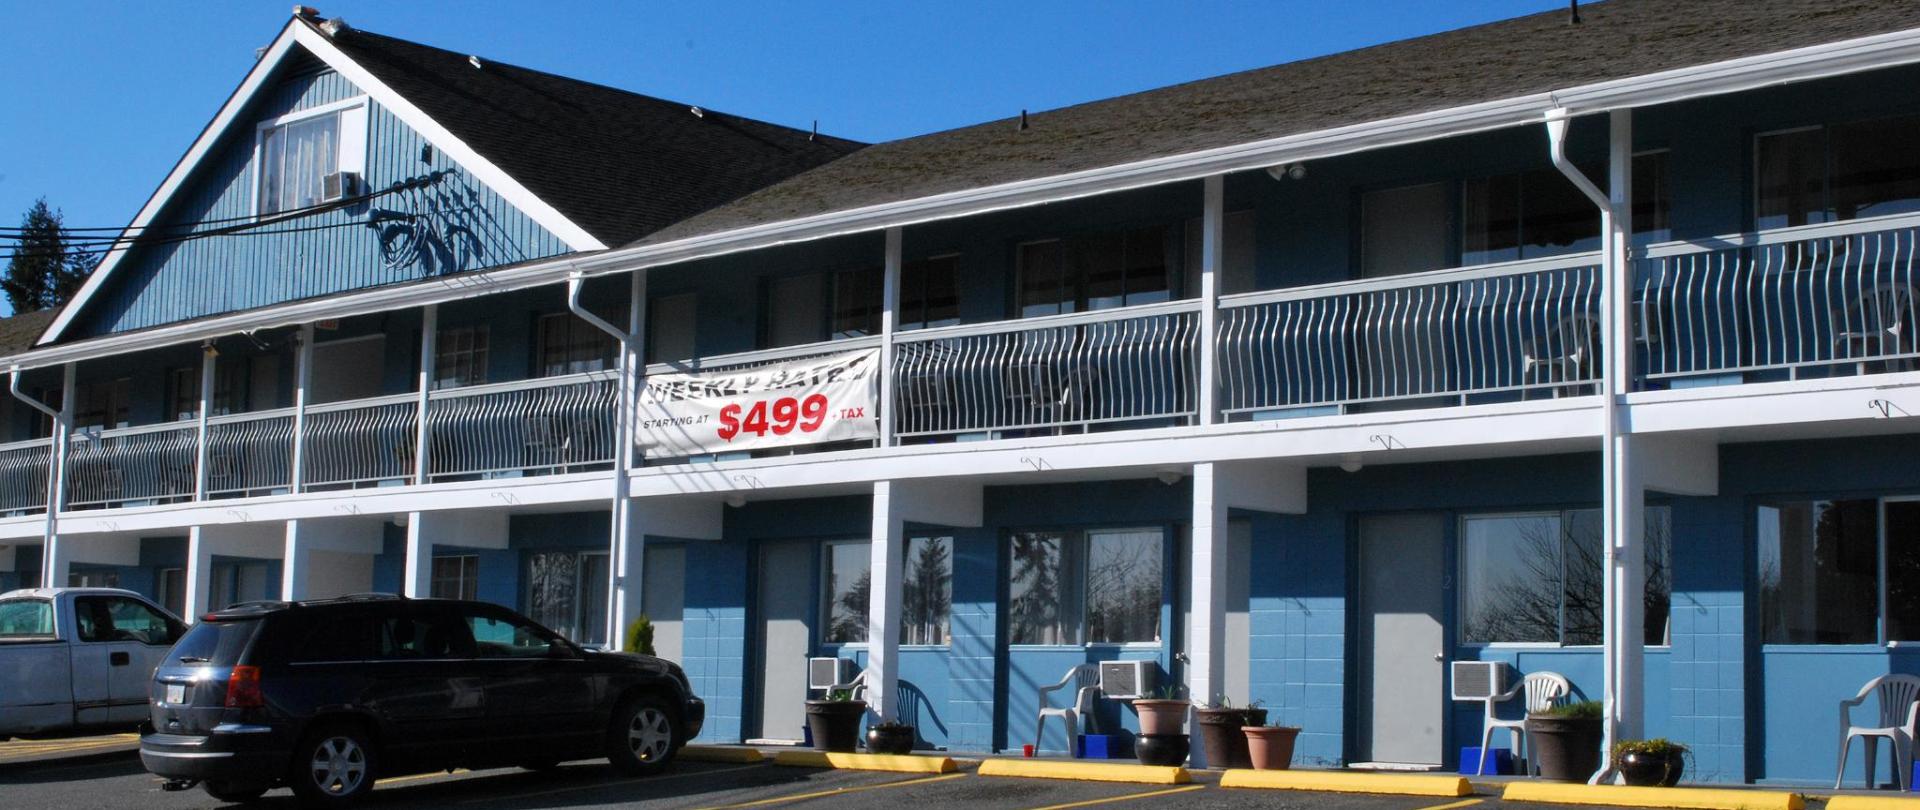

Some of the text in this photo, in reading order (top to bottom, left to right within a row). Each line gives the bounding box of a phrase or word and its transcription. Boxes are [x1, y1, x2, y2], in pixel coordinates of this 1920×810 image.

[648, 376, 760, 403] WEEKLY
[643, 416, 693, 429] STARTING
[696, 414, 709, 425] AT
[717, 393, 828, 442] $499
[840, 407, 864, 419] TAX
